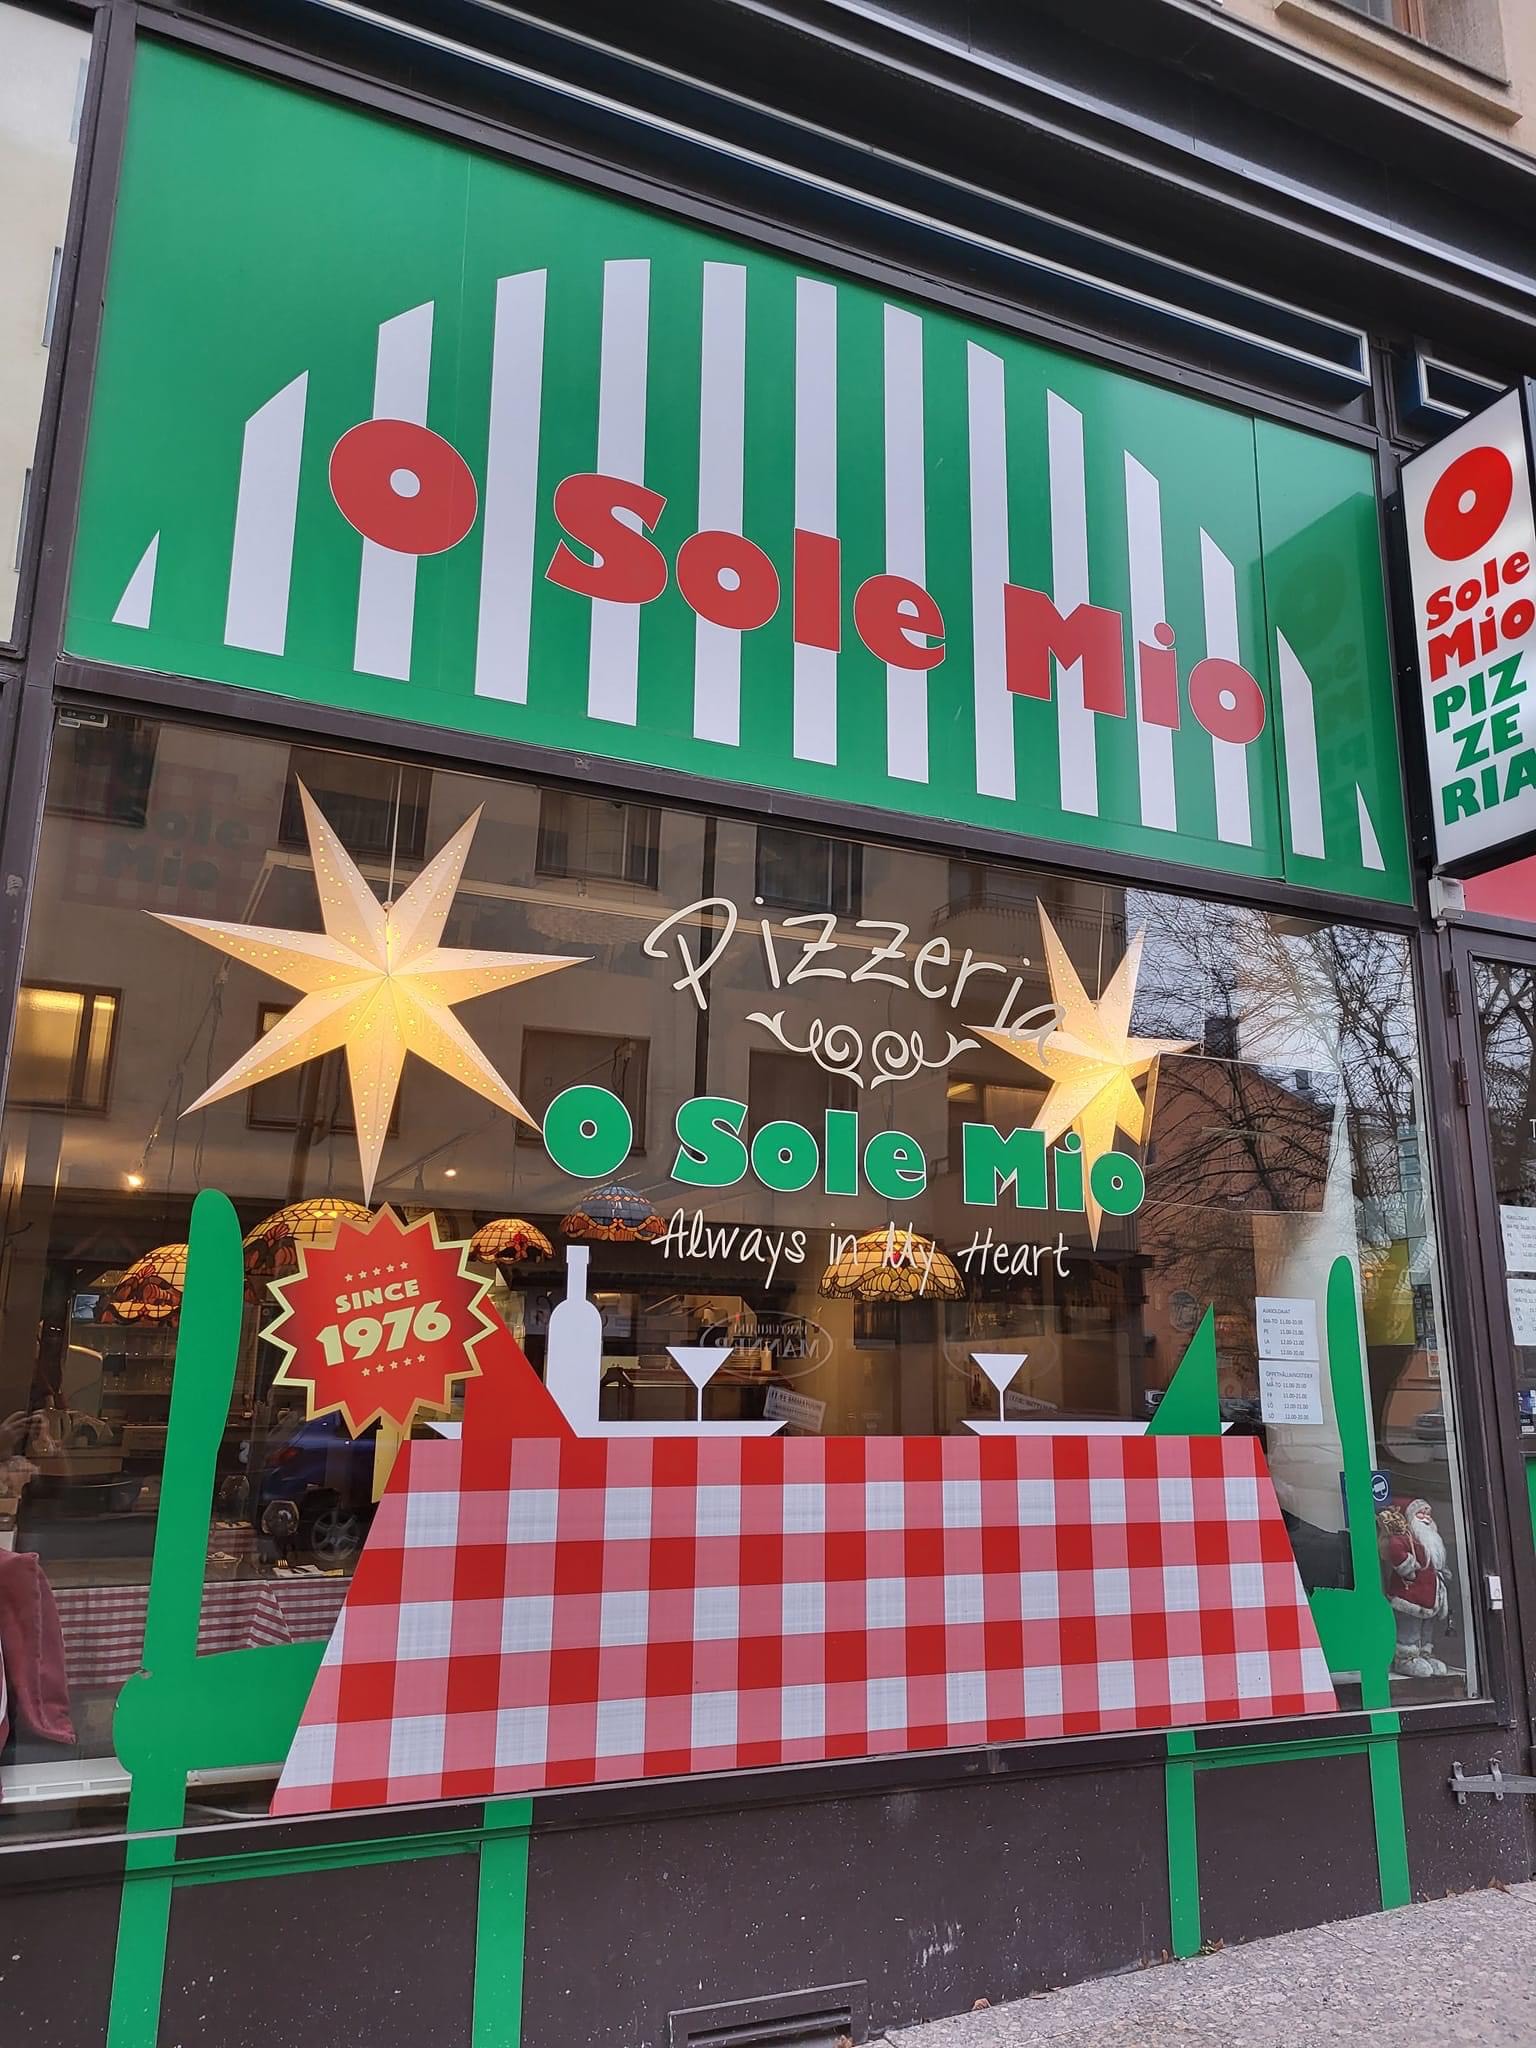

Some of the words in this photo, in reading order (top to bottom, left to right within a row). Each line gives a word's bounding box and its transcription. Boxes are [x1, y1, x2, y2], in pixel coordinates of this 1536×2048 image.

[1424, 446, 1513, 561] O
[329, 418, 478, 556] O
[544, 473, 946, 671] Sole
[1003, 582, 1267, 745] Mio
[1426, 551, 1530, 630] Sole
[1426, 598, 1535, 682] Mio
[1431, 650, 1527, 733] PIZ
[1452, 706, 1523, 772] ZE
[1441, 748, 1536, 826] RIA
[643, 896, 1066, 1066] Pizzeria
[542, 1084, 633, 1179] O
[671, 1096, 927, 1200] Sole
[962, 1121, 1145, 1216] Mio
[650, 1208, 806, 1290] Always
[829, 1222, 860, 1268] in
[880, 1221, 936, 1296] My
[957, 1227, 1070, 1279] Heart
[315, 1299, 451, 1367] 1976
[335, 1279, 421, 1314] SINCE
